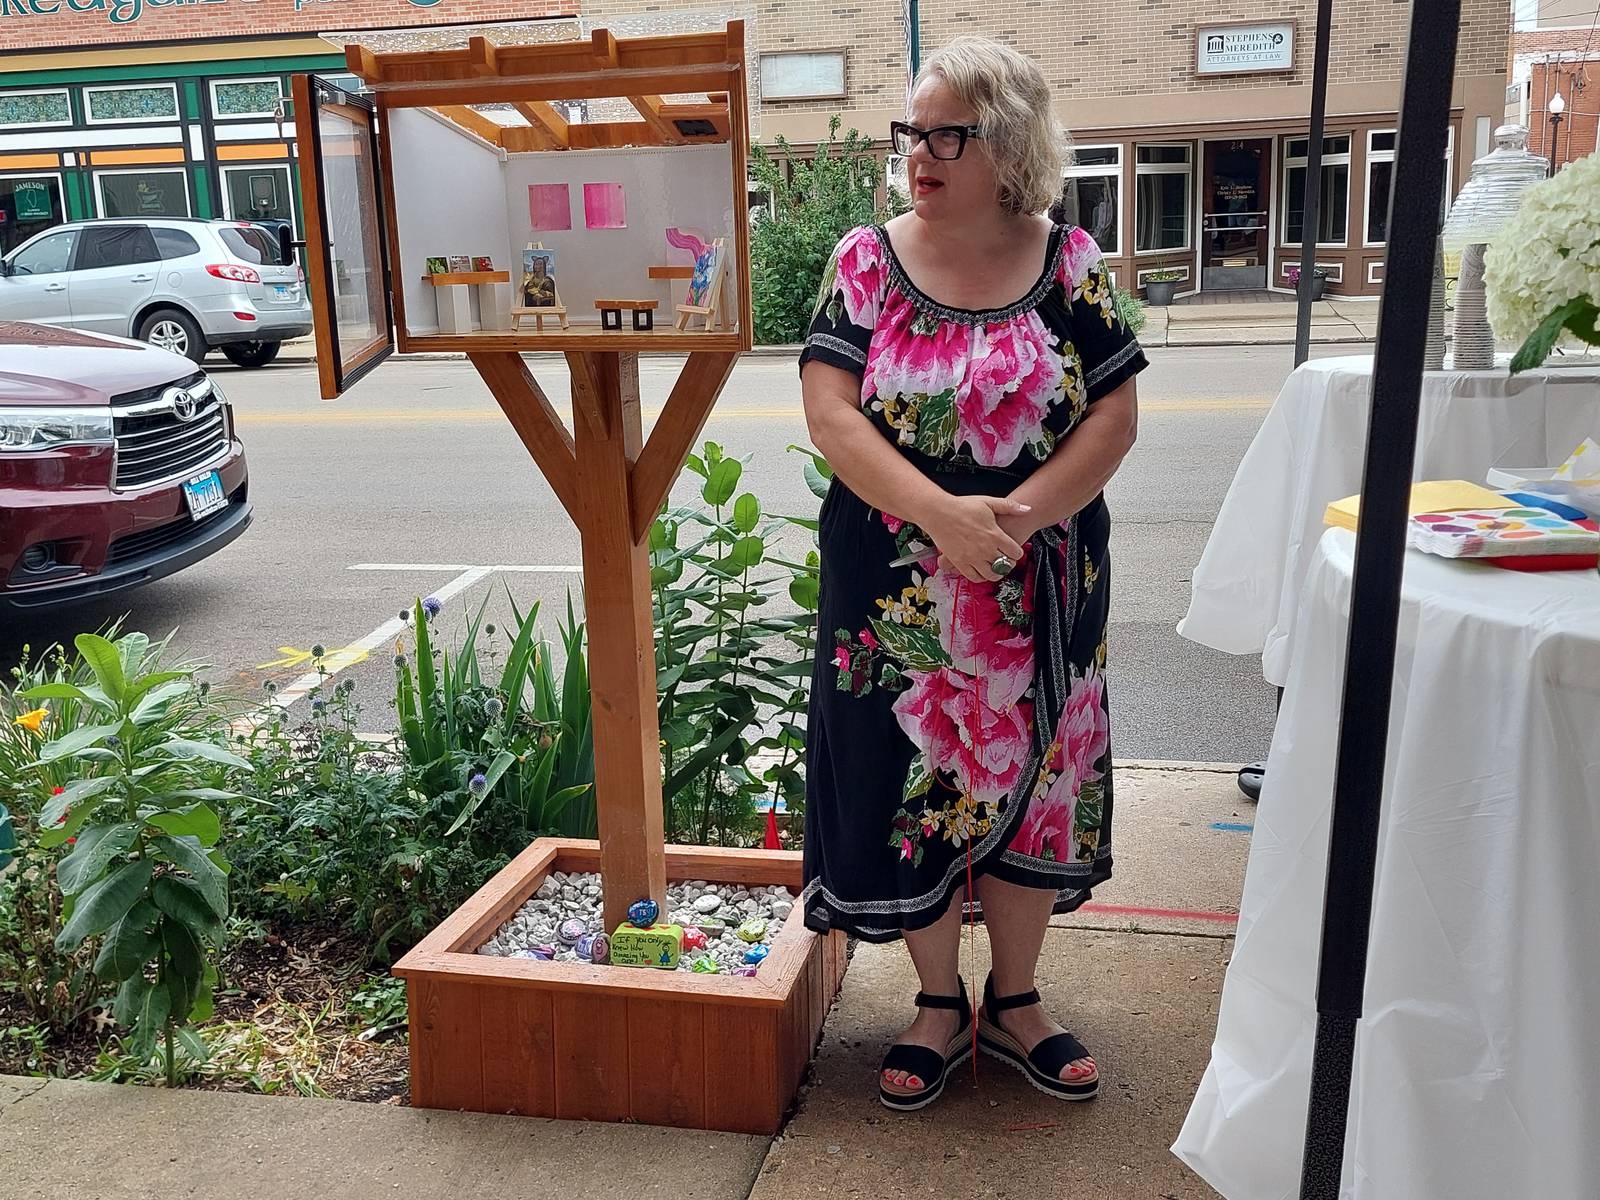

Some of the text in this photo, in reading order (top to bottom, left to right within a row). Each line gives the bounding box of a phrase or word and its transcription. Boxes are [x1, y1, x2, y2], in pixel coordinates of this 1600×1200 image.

[1225, 33, 1273, 43] STEPHENS
[1225, 42, 1275, 52] MEREDITH
[1207, 55, 1250, 63] ATTORNEYS
[15, 181, 45, 192] JAMESON
